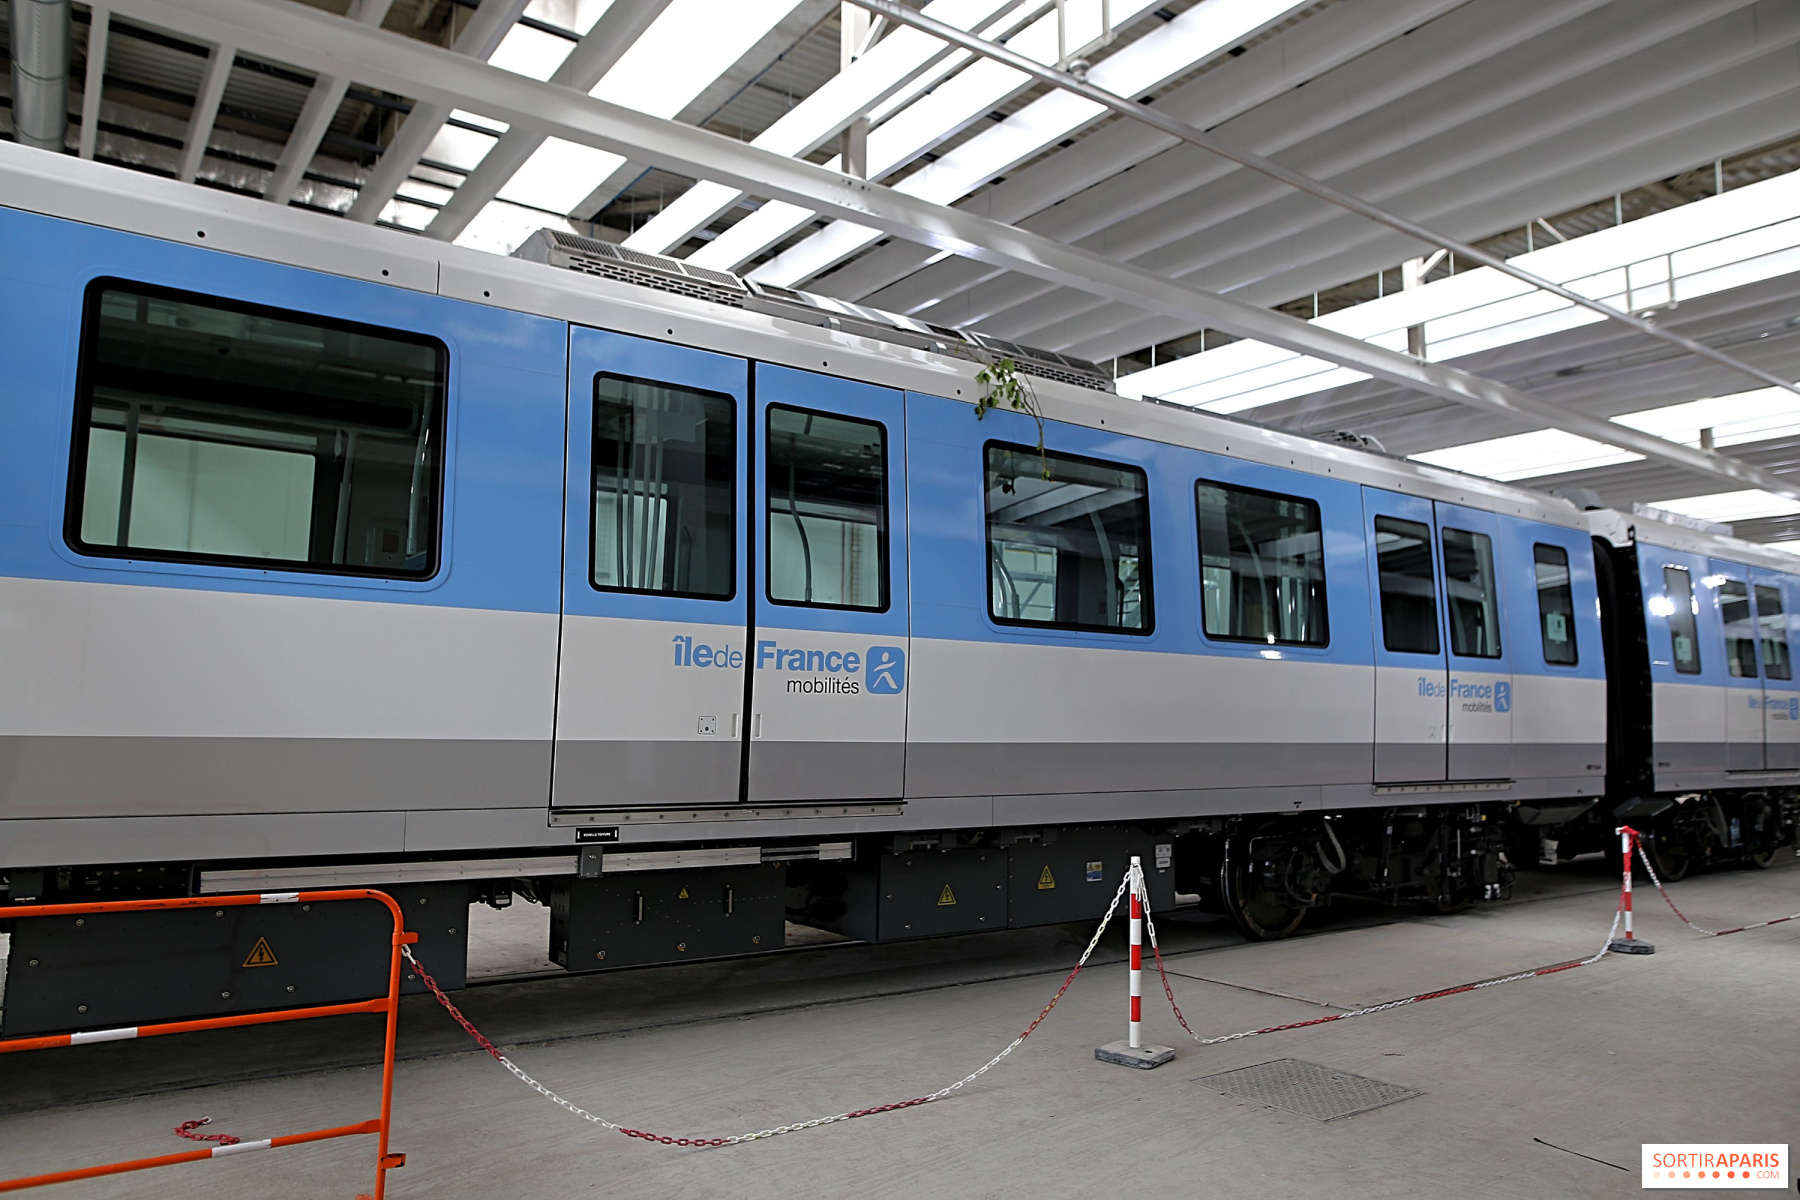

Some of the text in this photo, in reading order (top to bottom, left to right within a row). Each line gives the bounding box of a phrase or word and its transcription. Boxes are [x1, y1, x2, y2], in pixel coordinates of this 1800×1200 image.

[756, 640, 861, 673] France
[786, 676, 860, 695] mobilités
[1450, 679, 1493, 699] France
[1461, 700, 1493, 713] mobilités
